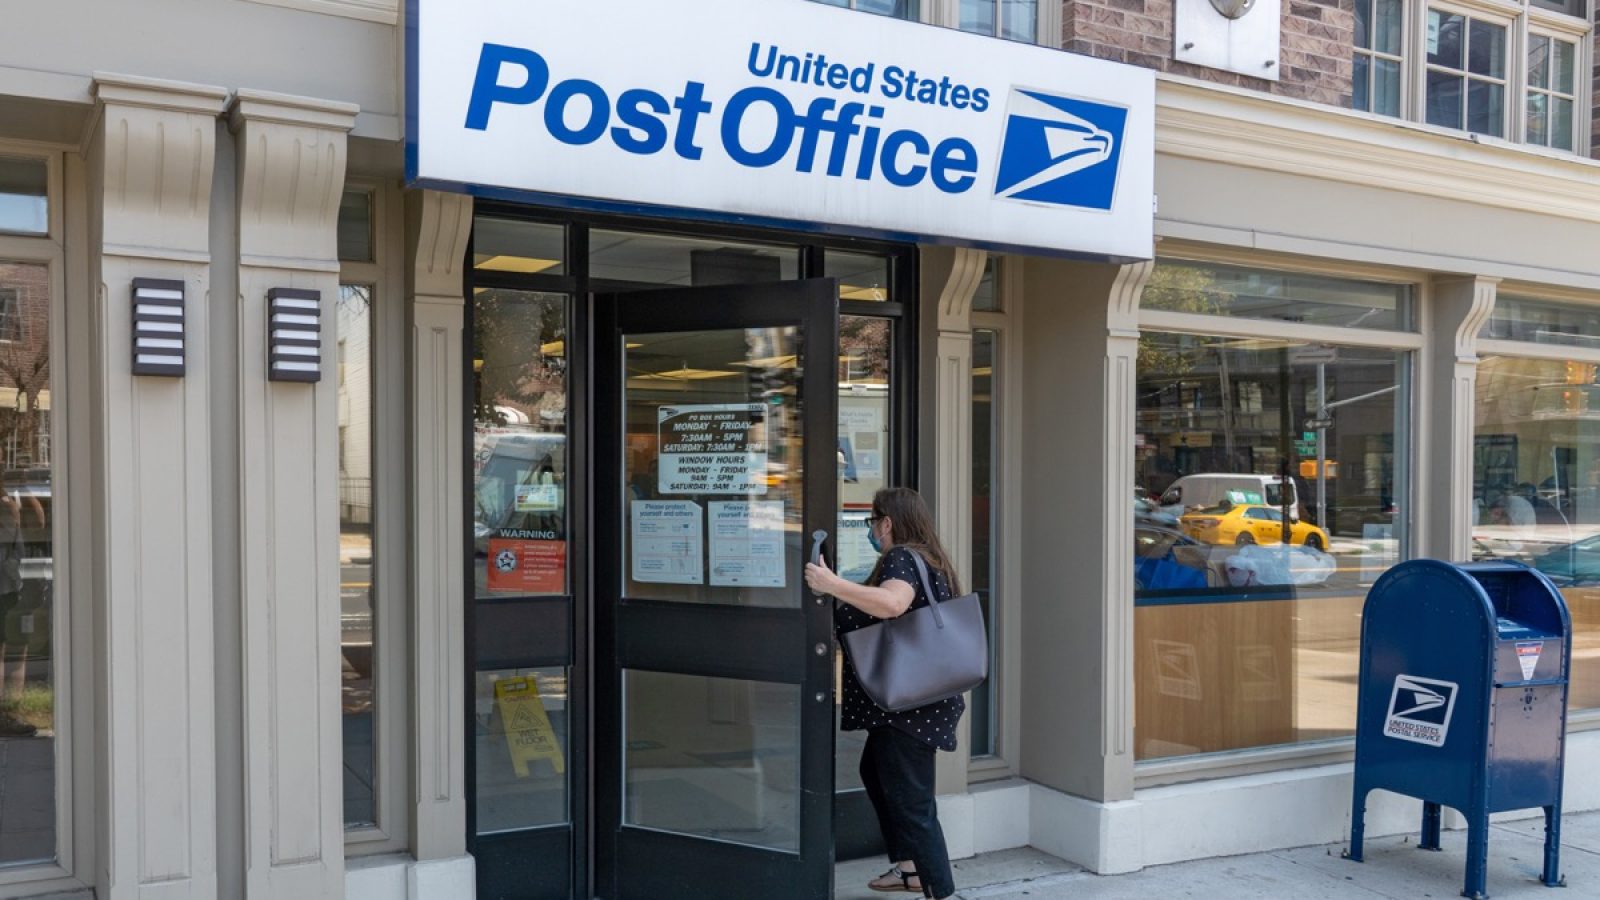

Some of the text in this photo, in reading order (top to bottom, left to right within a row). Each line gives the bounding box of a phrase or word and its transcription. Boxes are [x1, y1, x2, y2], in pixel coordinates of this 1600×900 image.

[748, 42, 990, 113] United States
[464, 42, 978, 194] Post Office
[673, 422, 710, 431] MONDAY
[720, 421, 752, 430] FRIDAY
[680, 433, 713, 442] 7:30AM
[723, 432, 744, 441] 5PM
[664, 443, 705, 452] SATURDAY:
[706, 443, 736, 452] 7:30AM
[678, 456, 745, 464] WINDOW HOURS
[665, 503, 686, 511] protect
[717, 511, 742, 519] yourself
[500, 529, 556, 539] WARNING
[1389, 719, 1440, 735] UNITED STATES
[1388, 726, 1441, 742] POSTAL SERVICE
